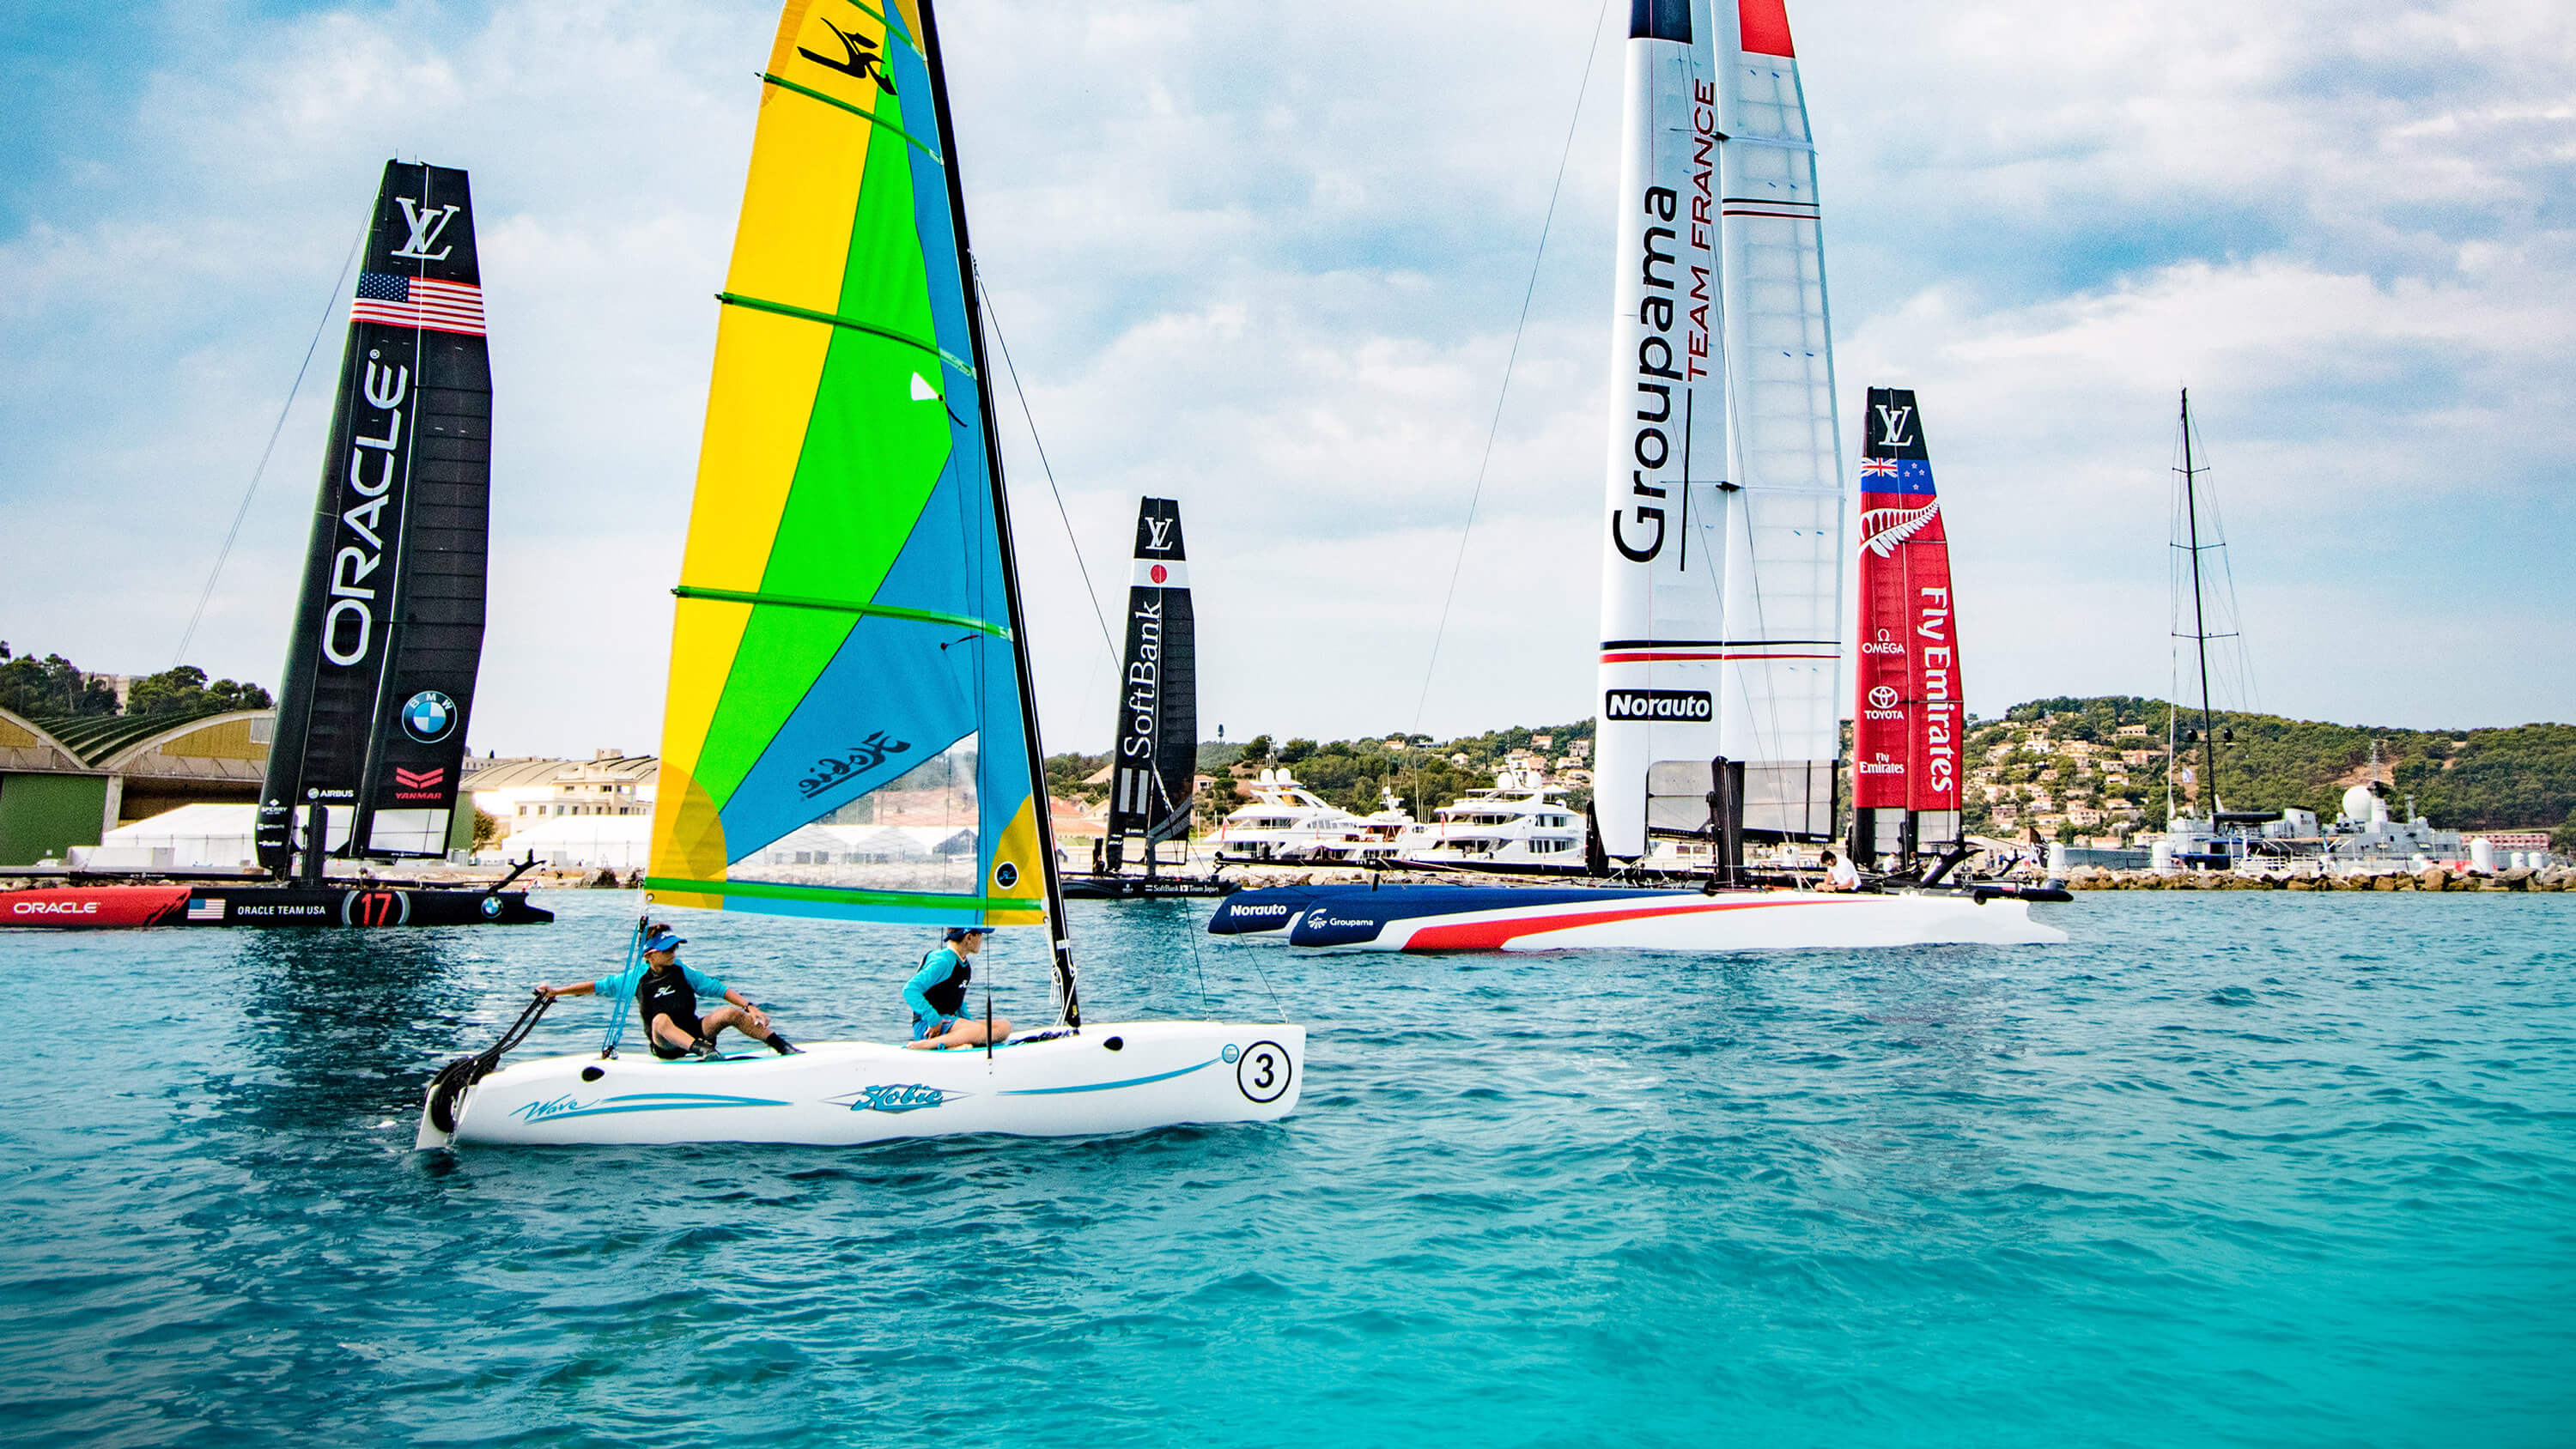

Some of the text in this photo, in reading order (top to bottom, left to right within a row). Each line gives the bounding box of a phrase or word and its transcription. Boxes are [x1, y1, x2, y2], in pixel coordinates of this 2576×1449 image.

[1688, 78, 1716, 381] TEAM FRANCE
[1613, 185, 1683, 563] Groupama
[1862, 642, 1905, 654] OMEGA
[1124, 601, 1160, 759] SoftBank
[1917, 586, 1955, 792] Fly Emirates
[409, 693, 453, 711] BMW
[1608, 694, 1710, 718] Norauto
[1864, 710, 1904, 720] TOYOTA
[1875, 753, 1889, 763] Fly
[1860, 761, 1905, 774] Emirates
[319, 789, 354, 797] AIRBUS
[1204, 884, 1219, 894] Japan
[237, 906, 326, 916] ORACLE TEAM USA
[361, 893, 392, 926] 17
[1230, 903, 1287, 917] Norauto
[1329, 918, 1374, 928] Groupama
[1255, 1053, 1274, 1088] 3
[851, 1083, 944, 1111] Hobie
[508, 1093, 599, 1120] Wave
